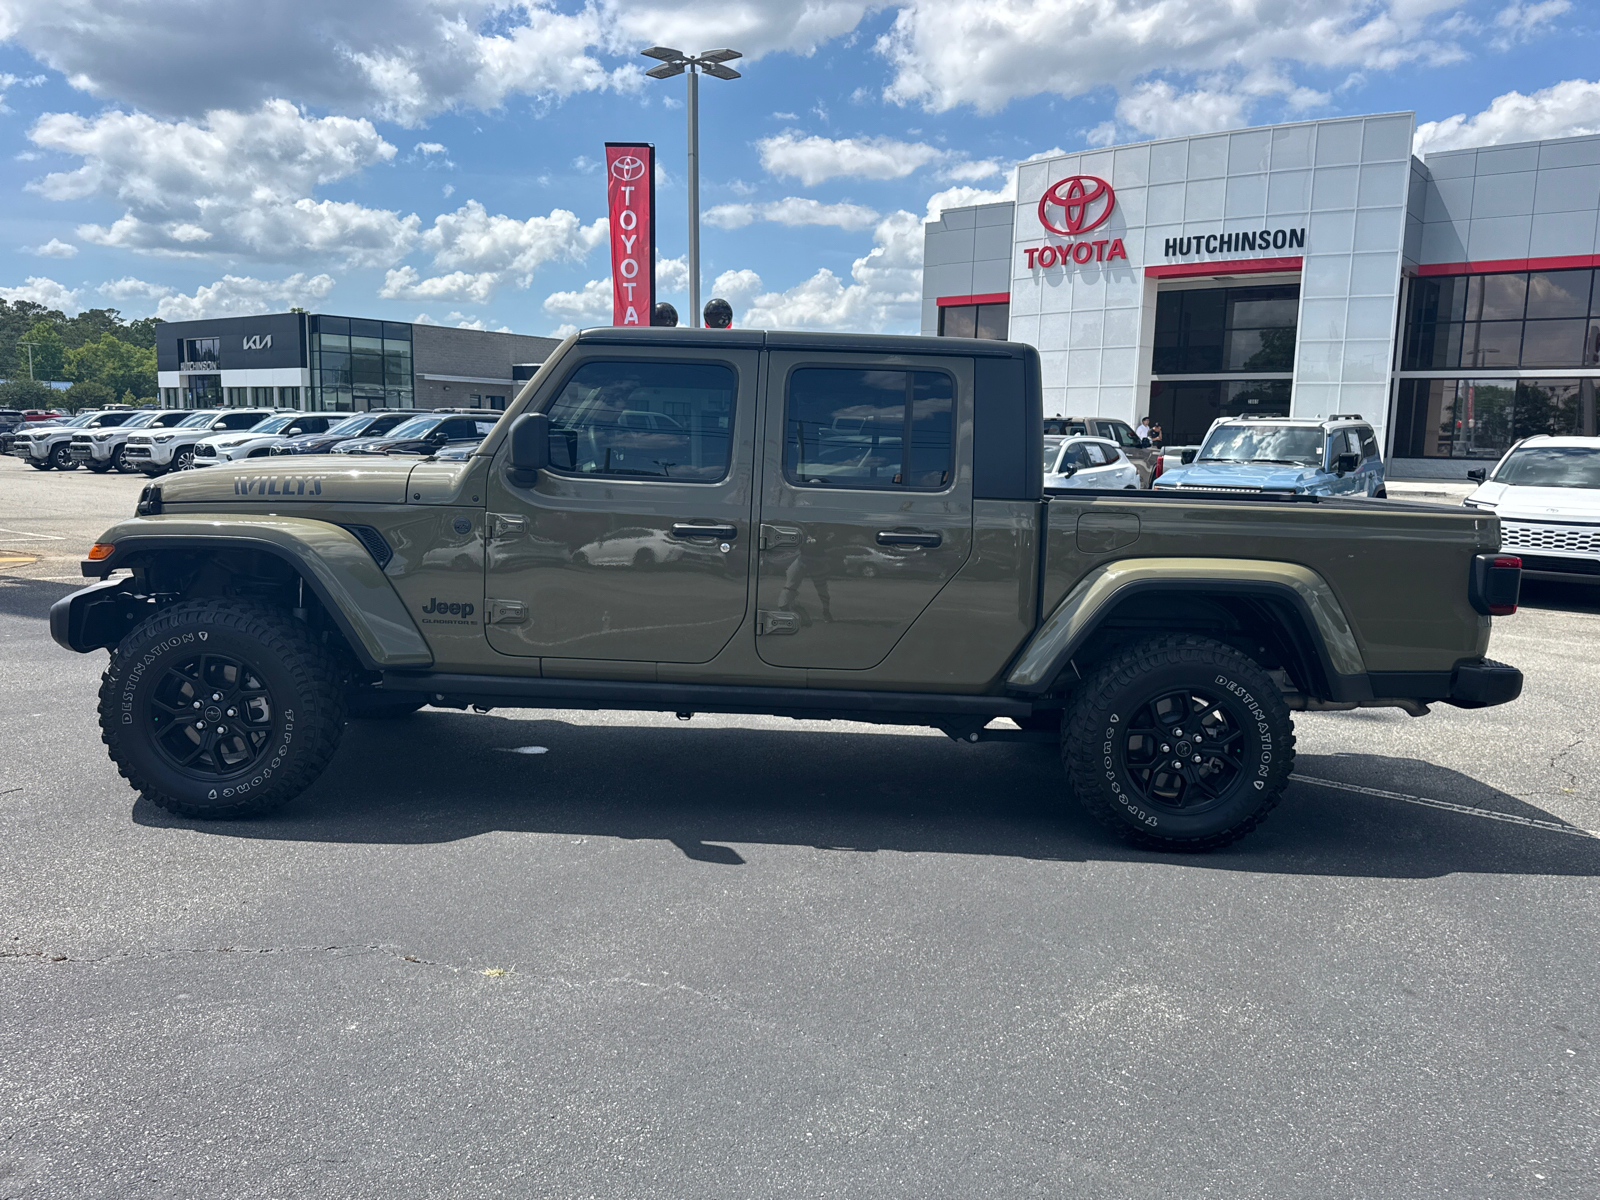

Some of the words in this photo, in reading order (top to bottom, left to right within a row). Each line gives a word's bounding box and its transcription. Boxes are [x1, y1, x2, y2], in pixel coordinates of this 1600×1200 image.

[619, 186, 639, 325] TOYOTA
[1024, 238, 1127, 269] TOYOTA
[1164, 228, 1306, 257] HUTCHINSON
[243, 334, 272, 350] KIA
[180, 361, 217, 371] HUTCHINSON
[234, 475, 327, 496] WILLYS
[422, 597, 474, 618] Jeep
[122, 631, 195, 724] DESTINATION
[1214, 674, 1273, 778] DESTINATION
[222, 709, 294, 798] Firestone
[1102, 725, 1159, 827] Firestone
